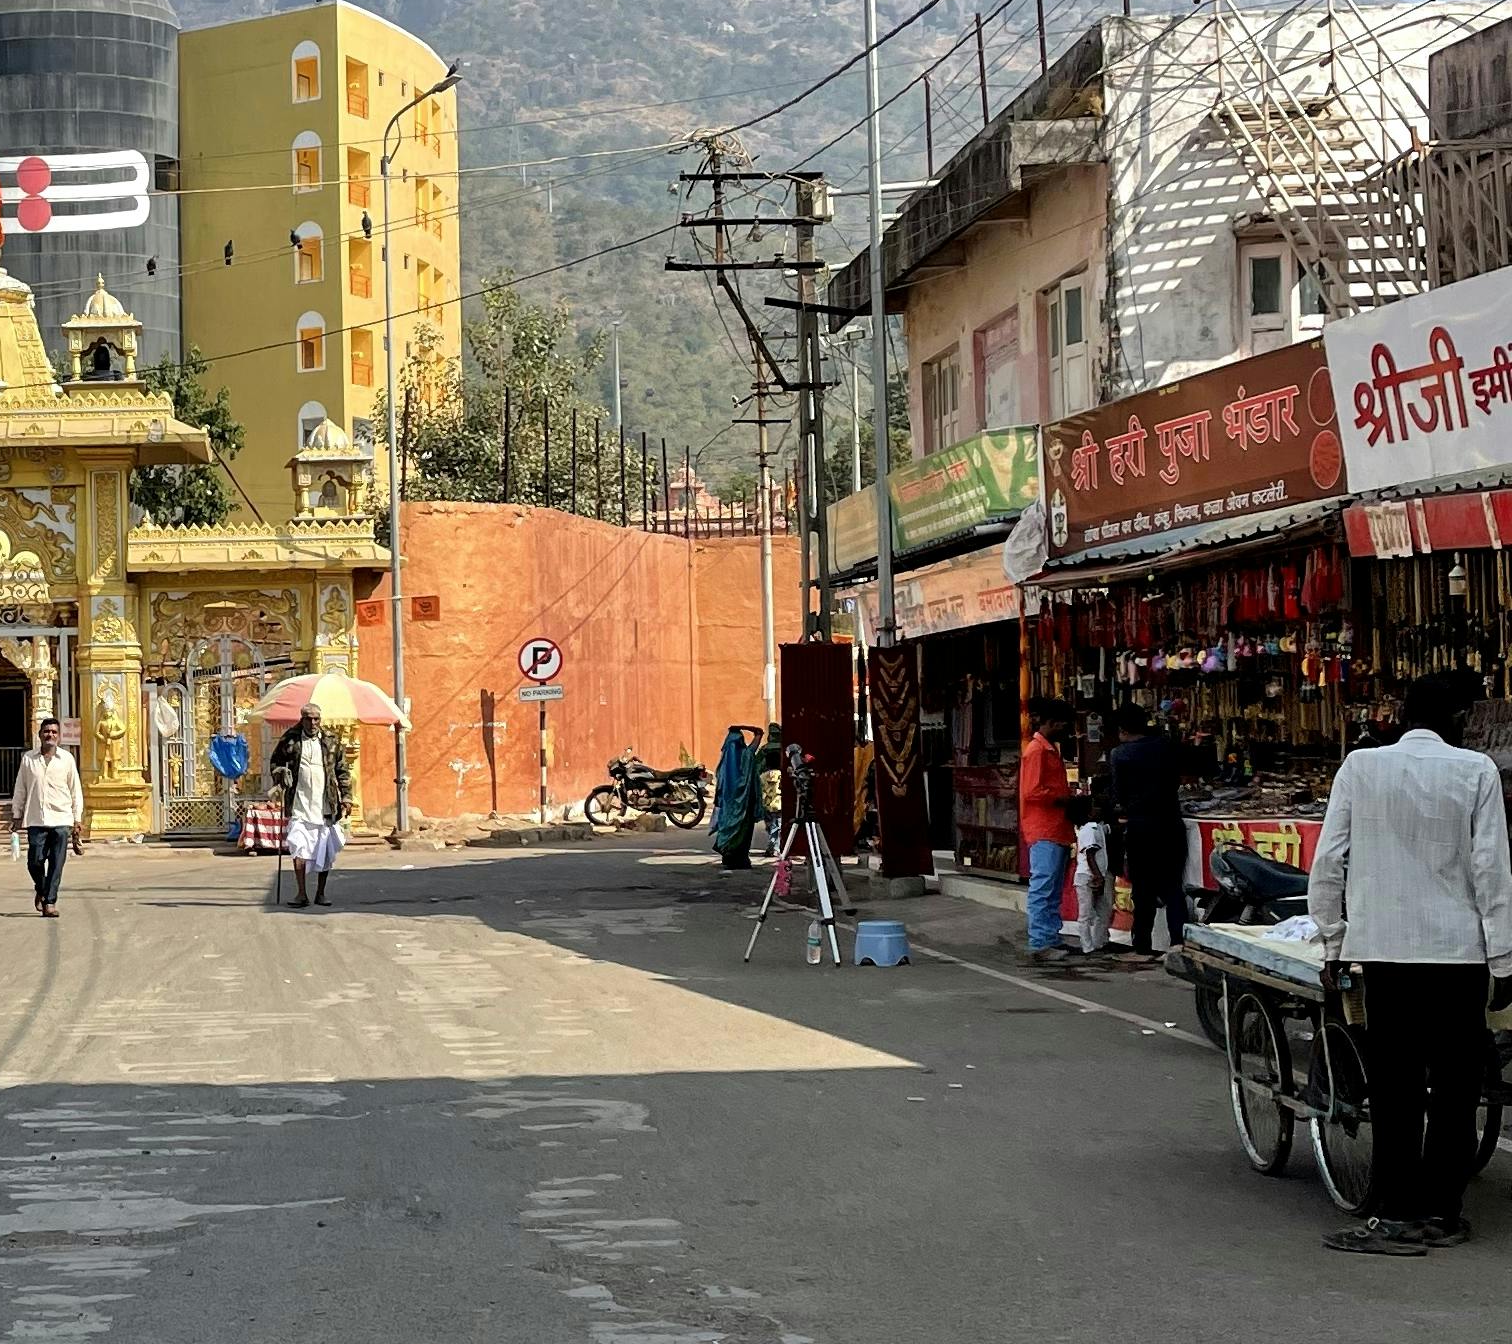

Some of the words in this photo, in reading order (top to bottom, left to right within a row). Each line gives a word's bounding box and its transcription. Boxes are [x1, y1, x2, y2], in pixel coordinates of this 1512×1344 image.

[1354, 326, 1469, 447] श्रीजी
[1468, 343, 1512, 416] इमी
[1071, 430, 1099, 491] श्री
[1105, 414, 1148, 485] हरी
[1154, 409, 1212, 485] पुजा
[1222, 385, 1301, 451] भंडार
[533, 647, 552, 674] P
[533, 688, 561, 696] PARKING
